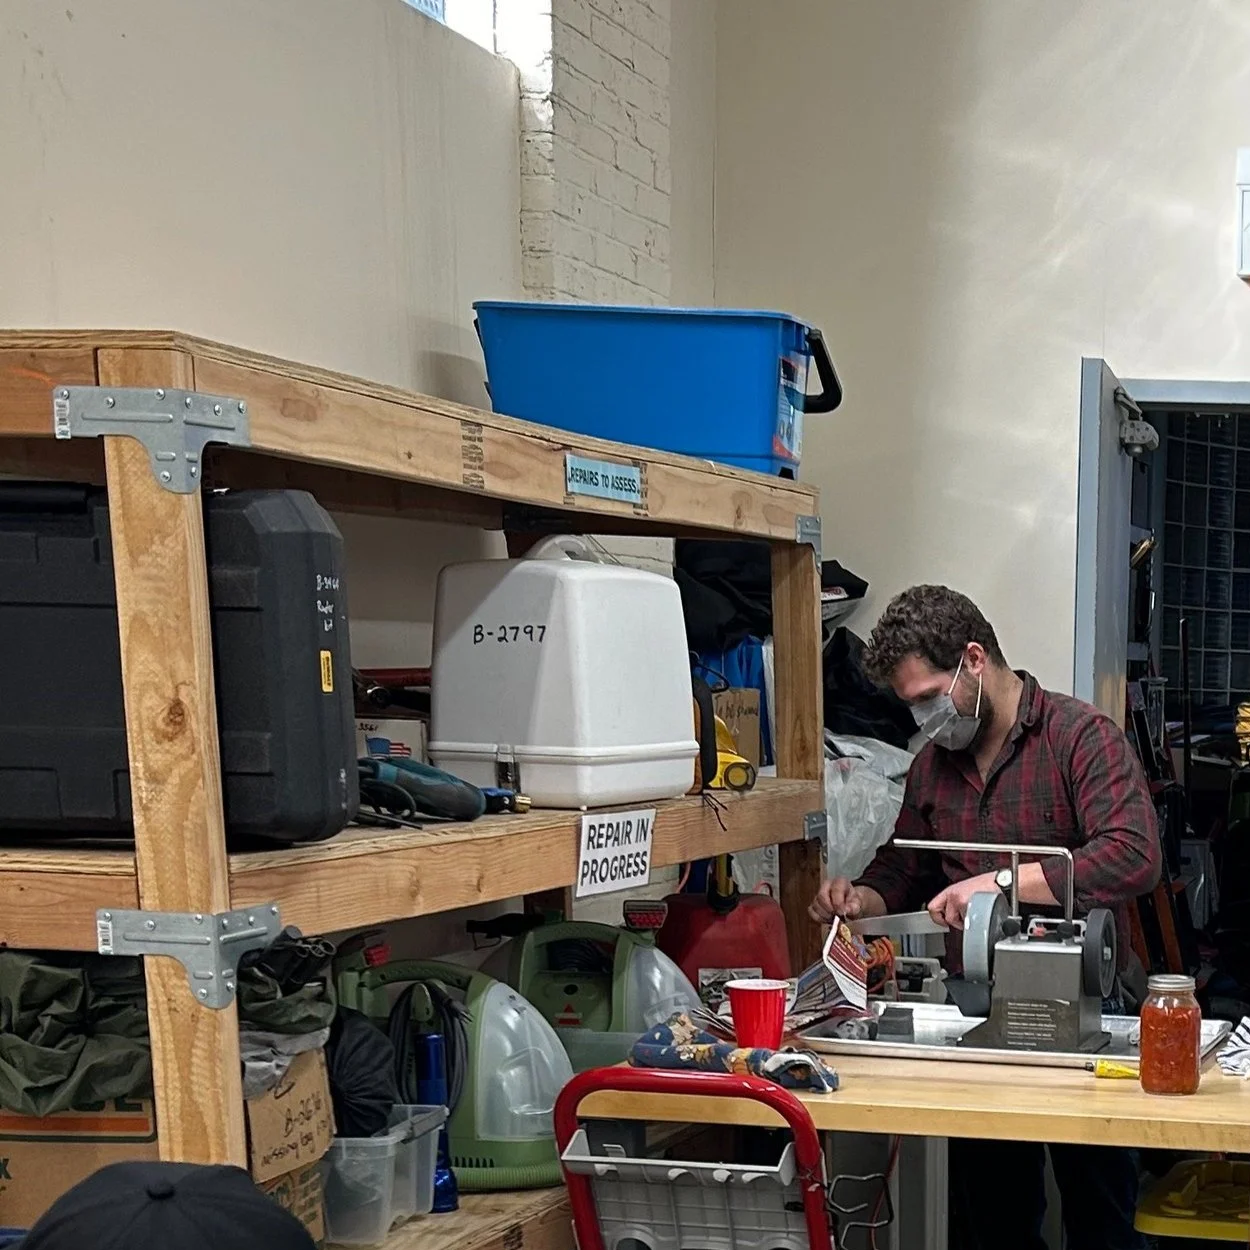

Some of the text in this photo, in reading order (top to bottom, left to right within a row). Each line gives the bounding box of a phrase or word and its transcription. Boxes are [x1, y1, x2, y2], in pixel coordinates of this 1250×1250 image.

[570, 466, 637, 495] REPAIRS TO ASSESS
[473, 624, 547, 645] B-2797
[586, 817, 650, 851] REPAIR IN
[580, 850, 648, 887] PROGRESS
